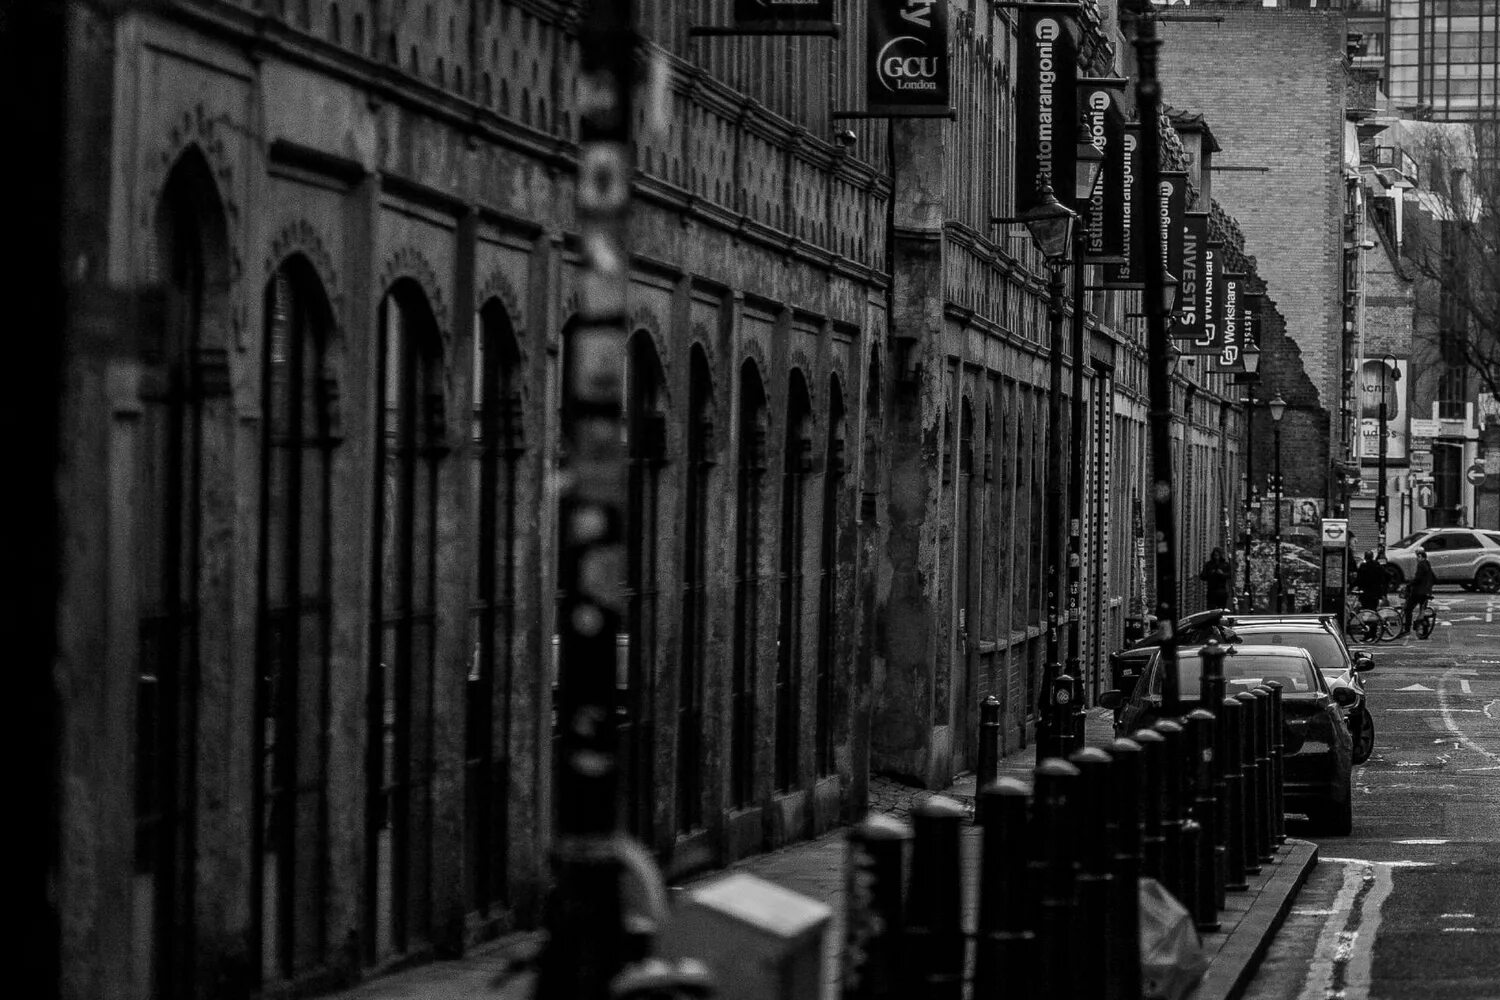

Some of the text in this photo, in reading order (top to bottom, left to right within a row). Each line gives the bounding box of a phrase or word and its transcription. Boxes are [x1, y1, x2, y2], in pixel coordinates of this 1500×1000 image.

[883, 56, 939, 79] GCU
[897, 79, 937, 91] London
[1224, 280, 1238, 344] Workshare
